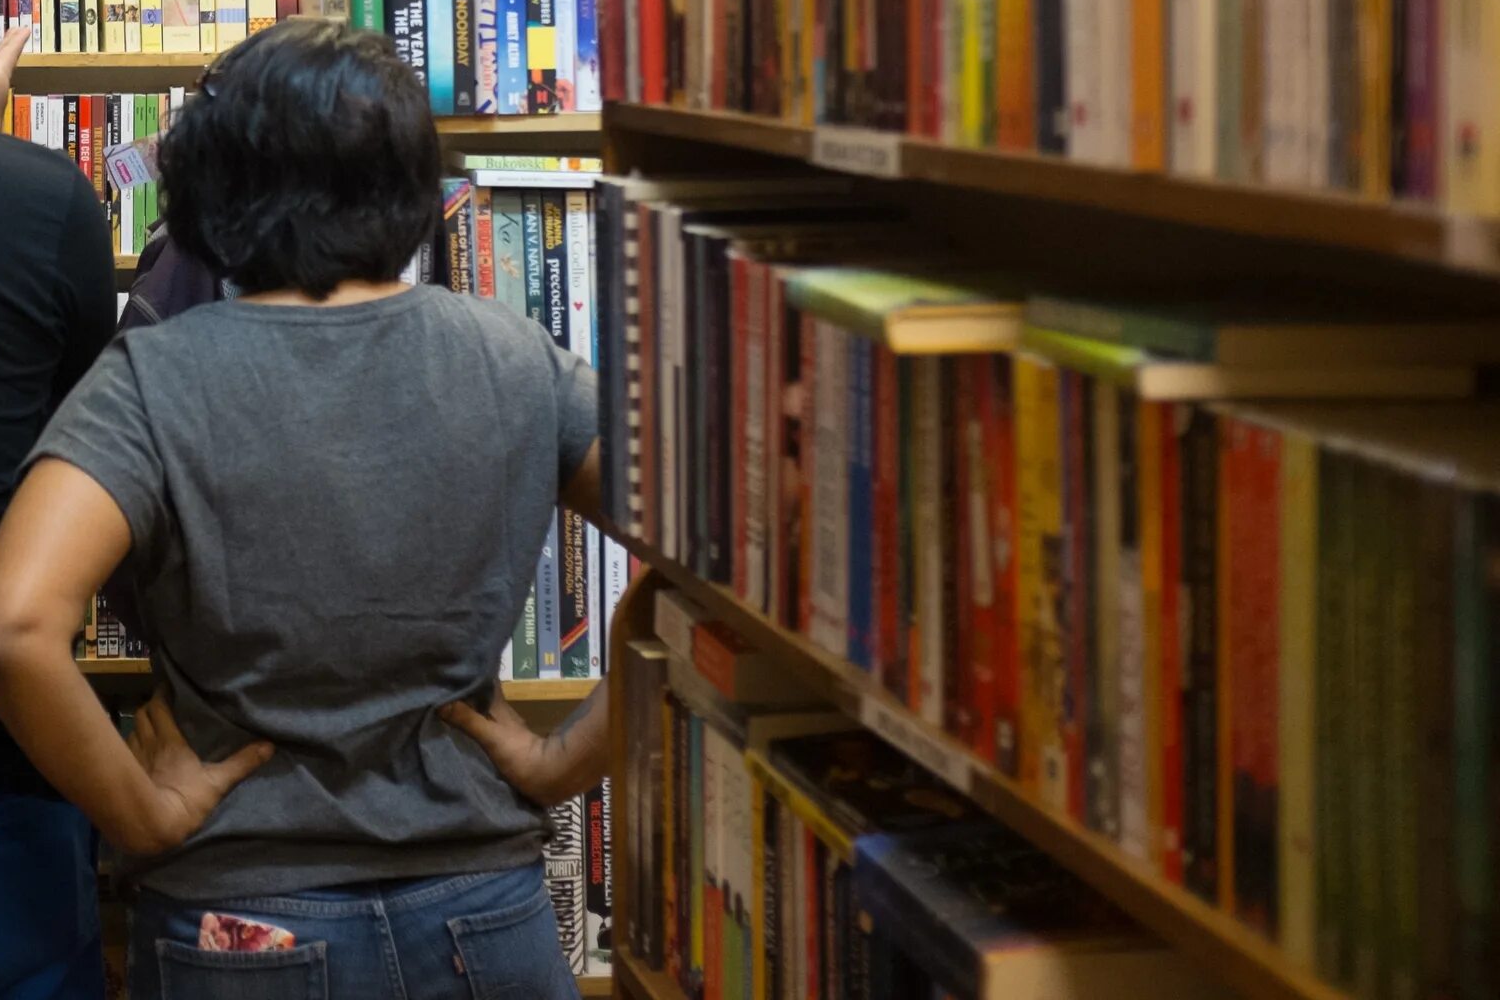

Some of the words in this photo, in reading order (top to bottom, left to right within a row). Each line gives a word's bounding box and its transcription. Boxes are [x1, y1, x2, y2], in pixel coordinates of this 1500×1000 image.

[409, 1, 423, 28] THE
[410, 31, 424, 67] YEAR
[455, 0, 468, 67] NOONDAY
[80, 128, 90, 144] YOU
[80, 146, 90, 162] CEO
[525, 203, 537, 233] MAN
[569, 202, 583, 238] Paulo
[449, 233, 459, 268] IMRAAN
[526, 234, 537, 246] V.
[527, 252, 540, 297] NATURE
[570, 240, 585, 289] Coelho
[546, 258, 565, 337] precocious
[564, 509, 573, 545] IMRAAN
[573, 514, 582, 528] OF
[574, 528, 583, 546] THE
[543, 564, 551, 595] KEVIN
[565, 545, 574, 594] COOVADIA
[574, 547, 584, 582] METRIC
[612, 560, 620, 596] WHITE
[544, 600, 552, 633] BARRY
[575, 582, 585, 619] SYSTEM
[590, 800, 601, 818] THE
[545, 860, 578, 876] PURITY
[592, 819, 603, 885] CORRECTIONS
